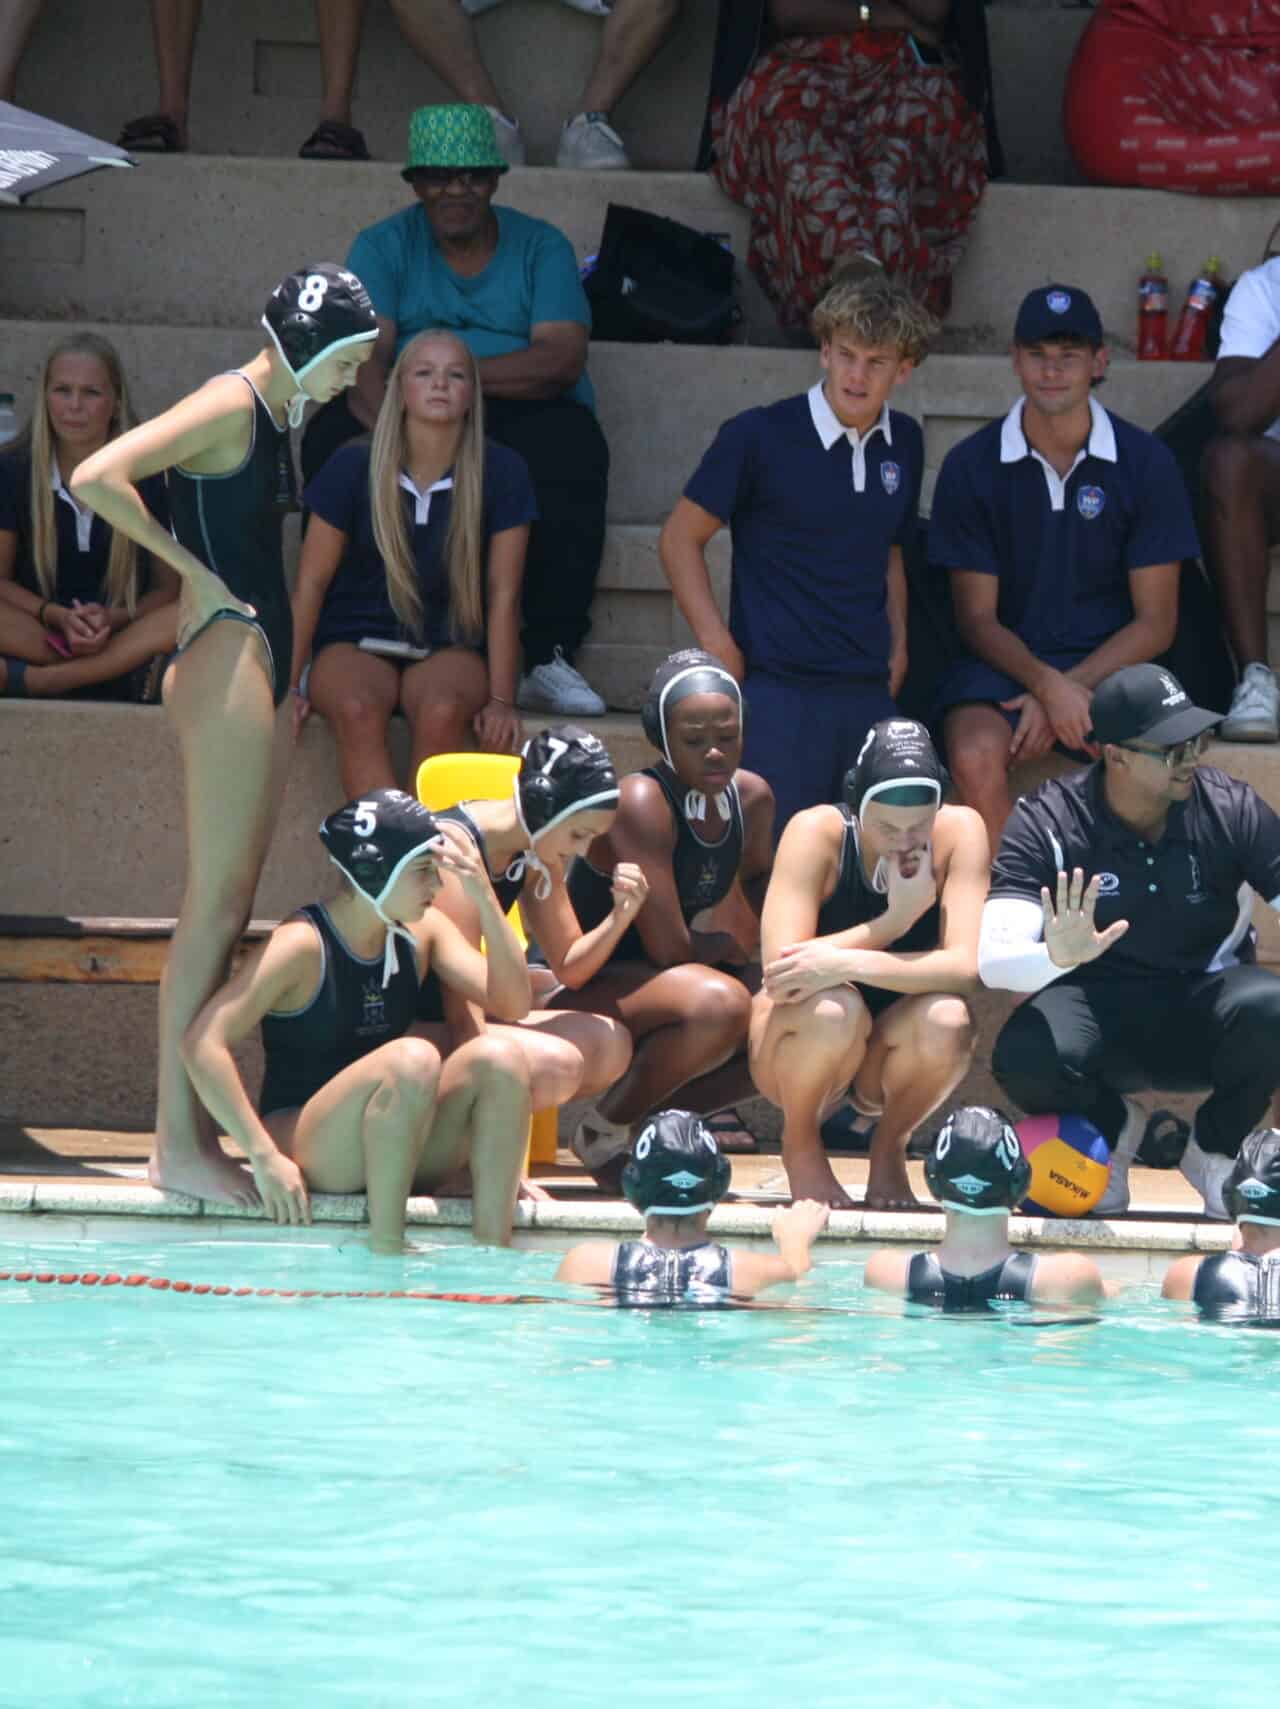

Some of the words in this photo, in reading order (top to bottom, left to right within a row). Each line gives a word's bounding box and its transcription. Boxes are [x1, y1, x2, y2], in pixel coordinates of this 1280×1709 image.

[298, 274, 328, 312] 8
[541, 737, 569, 776] 7
[353, 801, 378, 838] 5
[636, 1124, 656, 1160] 6
[995, 1124, 1020, 1171] 10
